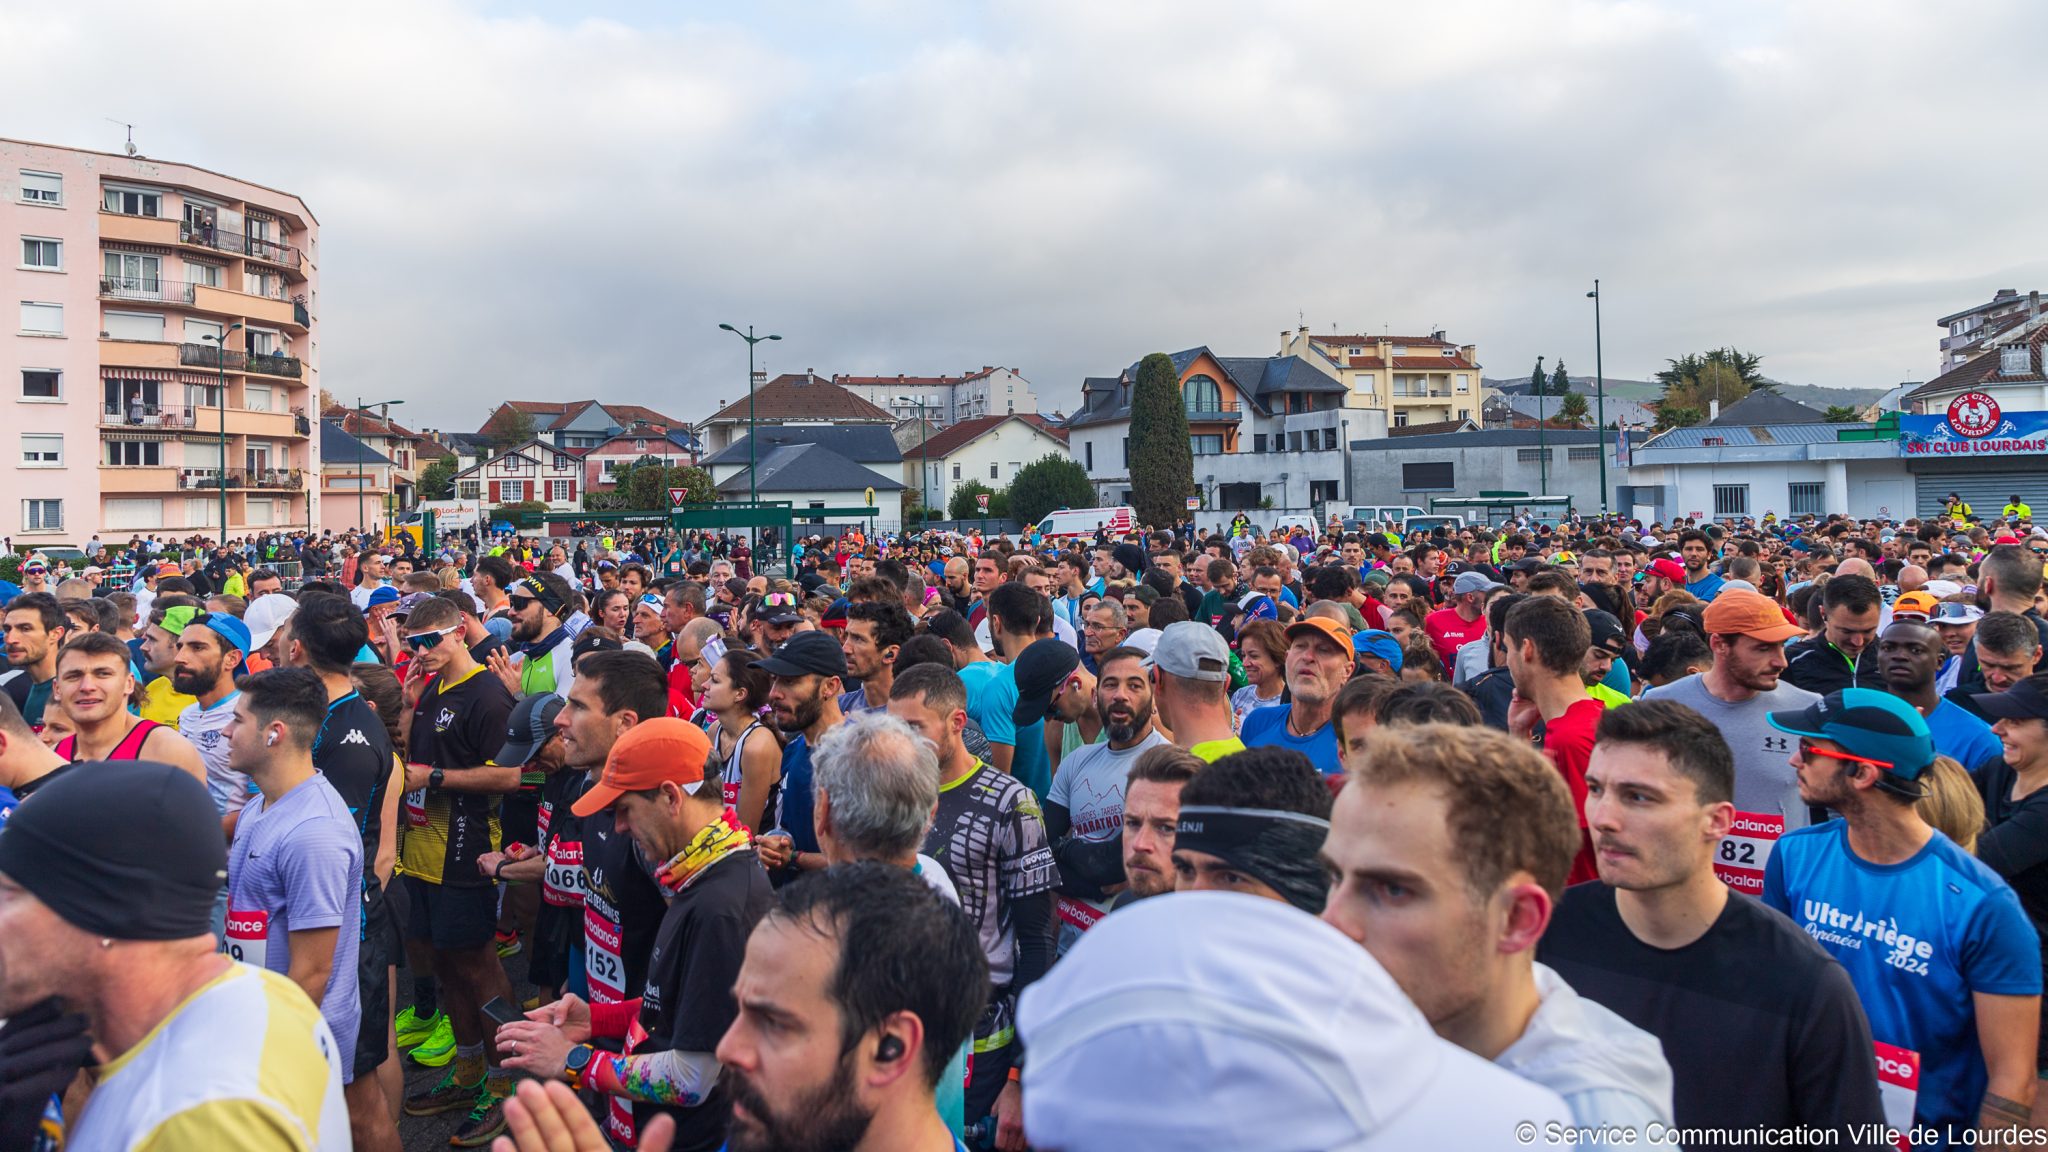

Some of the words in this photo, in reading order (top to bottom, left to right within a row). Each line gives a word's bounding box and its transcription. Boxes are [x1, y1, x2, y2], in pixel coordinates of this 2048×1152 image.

[1952, 395, 1969, 409] SKI
[1971, 394, 1996, 410] CLUB
[1951, 418, 1996, 436] LOURDAIS
[1907, 442, 1929, 453] SKI
[1933, 441, 1970, 453] CLUB
[1973, 439, 2046, 452] LOURDAIS
[1101, 804, 1123, 816] TARBES
[1721, 839, 1755, 865] 82
[589, 917, 619, 949] balance
[588, 946, 619, 982] 152
[1884, 950, 1929, 977] 2024
